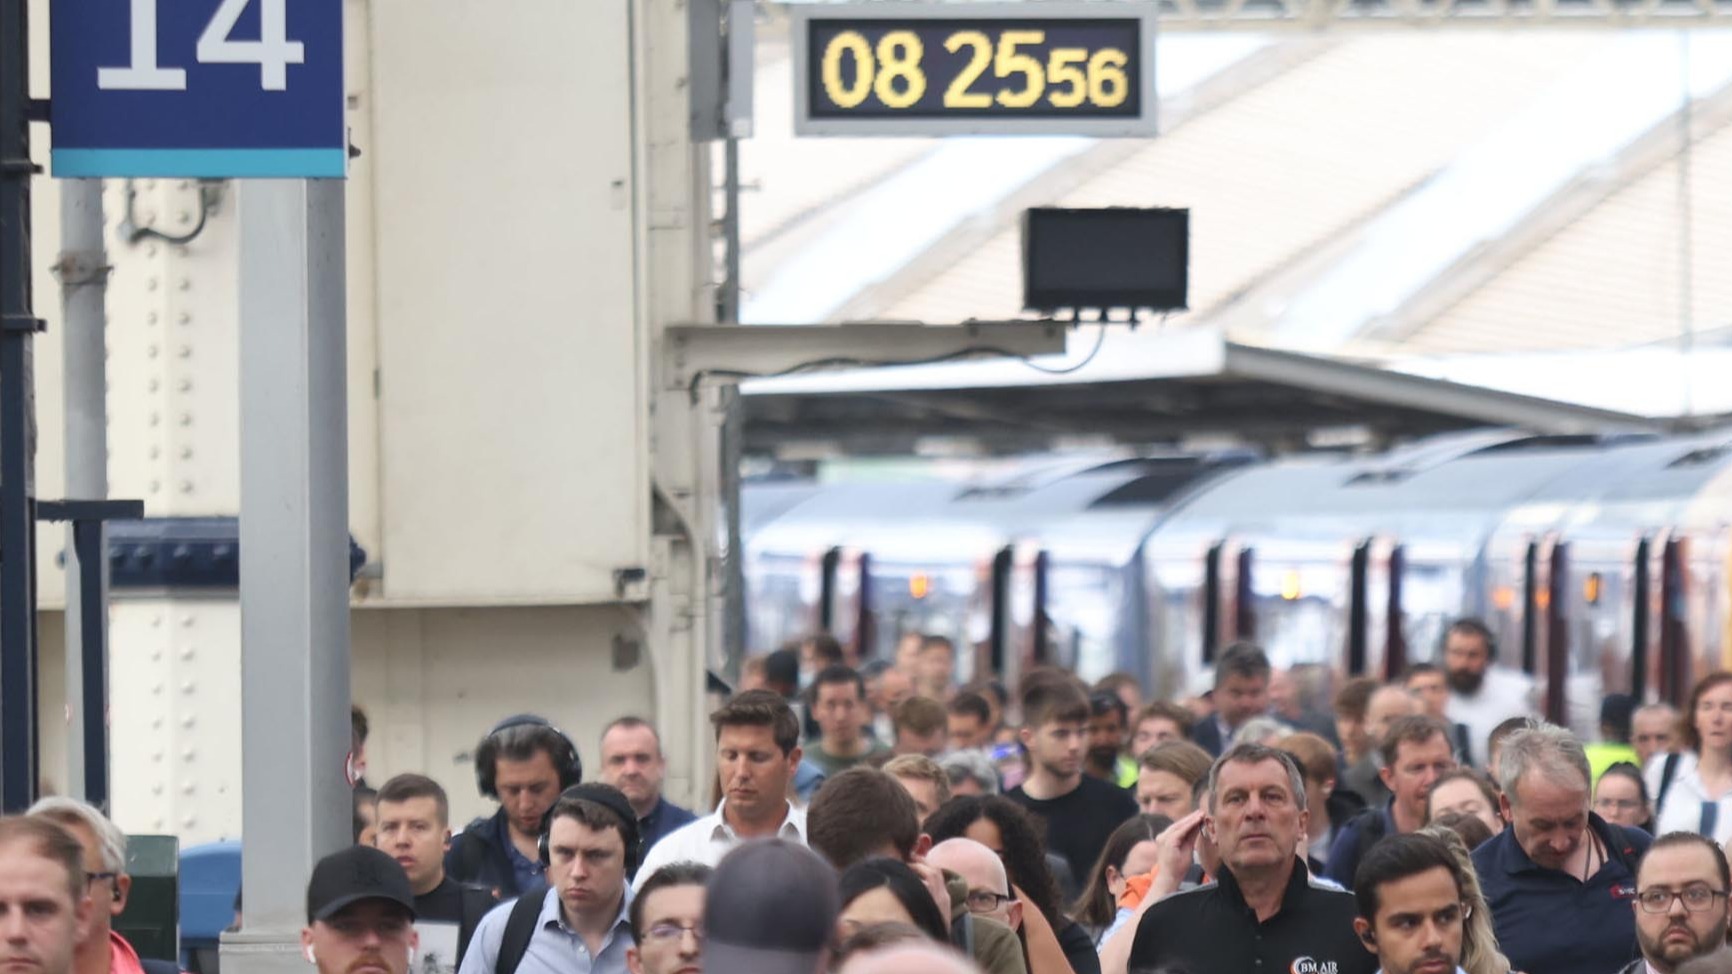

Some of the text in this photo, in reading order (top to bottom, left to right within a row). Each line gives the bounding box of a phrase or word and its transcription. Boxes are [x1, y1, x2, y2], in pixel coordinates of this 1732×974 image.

[97, 0, 305, 90] 14
[821, 30, 927, 108] 08
[1320, 961, 1338, 973] AIR
